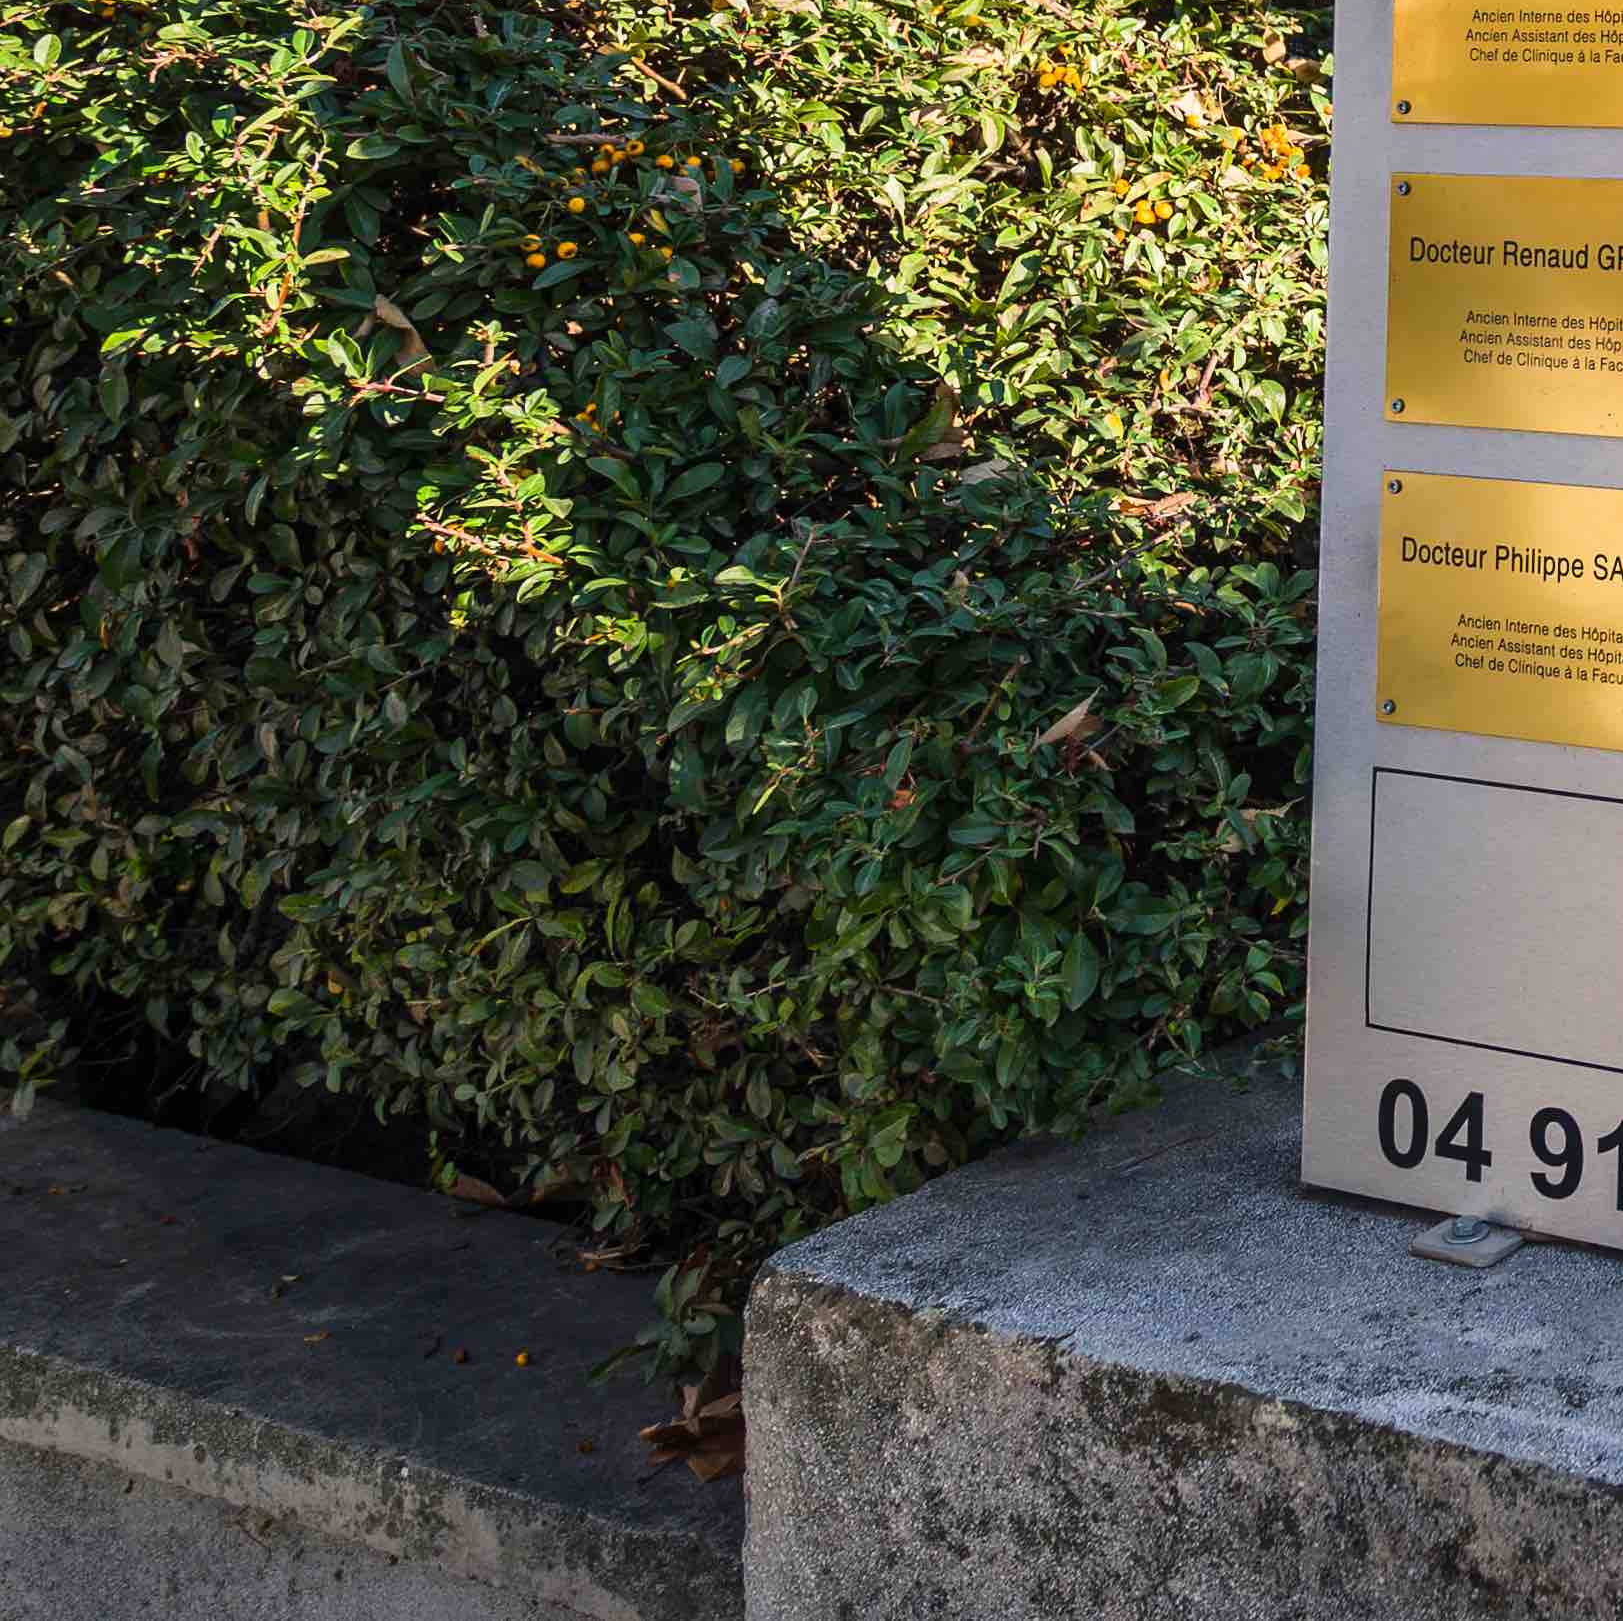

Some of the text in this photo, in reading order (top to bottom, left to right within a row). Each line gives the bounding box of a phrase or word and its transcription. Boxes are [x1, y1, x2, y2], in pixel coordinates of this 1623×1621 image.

[1472, 10, 1514, 24] Ancien
[1519, 10, 1562, 24] Interne
[1567, 10, 1590, 24] des
[1466, 29, 1508, 42] Ancien
[1512, 29, 1568, 43] Assistant
[1573, 31, 1596, 44] des
[1469, 48, 1499, 61] Chef
[1503, 48, 1518, 62] de
[1522, 49, 1573, 65] Clinique
[1578, 50, 1585, 63] à
[1589, 50, 1601, 63] la
[1410, 236, 1495, 265] Docteur
[1503, 240, 1588, 269] Renaud
[1466, 311, 1509, 326] Ancien
[1513, 313, 1557, 328] Interne
[1561, 315, 1584, 330] des
[1459, 330, 1502, 345] Ancien
[1506, 332, 1563, 349] Assistant
[1568, 335, 1591, 350] des
[1464, 350, 1493, 364] Chef
[1497, 351, 1513, 366] de
[1517, 352, 1568, 371] Clinique
[1572, 356, 1580, 370] à
[1584, 356, 1596, 371] la
[1402, 537, 1487, 570] Docteur
[1495, 545, 1584, 582] Philippe
[1458, 614, 1500, 631] Ancien
[1505, 618, 1549, 636] Interne
[1553, 623, 1577, 639] des
[1451, 633, 1493, 651] Ancien
[1498, 638, 1555, 658] Assistant
[1559, 644, 1583, 660] des
[1455, 652, 1484, 670] Chef
[1488, 656, 1504, 672] de
[1508, 658, 1560, 679] Clinique
[1564, 663, 1573, 680] à
[1576, 665, 1588, 681] la
[1376, 1078, 1493, 1183] 04
